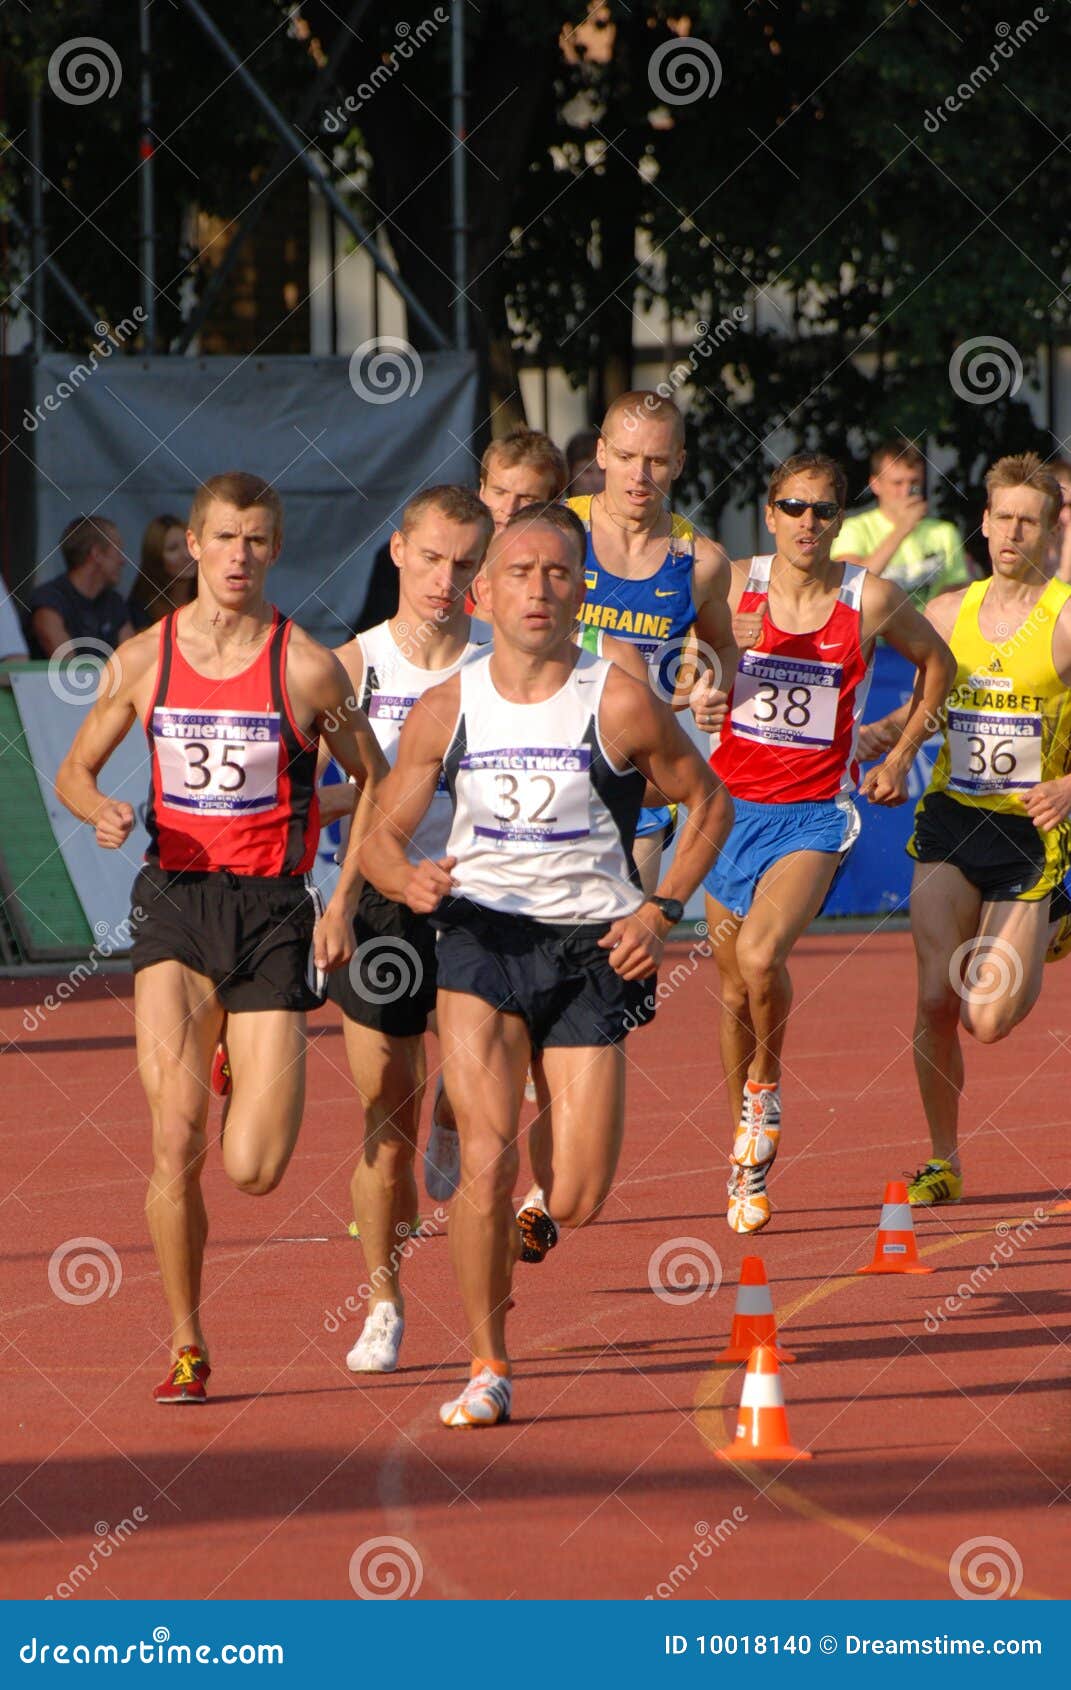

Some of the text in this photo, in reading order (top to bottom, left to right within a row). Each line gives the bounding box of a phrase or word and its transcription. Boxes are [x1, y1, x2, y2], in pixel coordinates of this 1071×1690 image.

[742, 665, 834, 686] атлетика
[753, 682, 812, 727] 38
[162, 722, 270, 740] атлетика
[953, 719, 1035, 736] атлетика
[184, 742, 246, 792] 35
[967, 736, 1017, 775] 36
[198, 800, 234, 809] OPEN
[494, 773, 558, 824] 32
